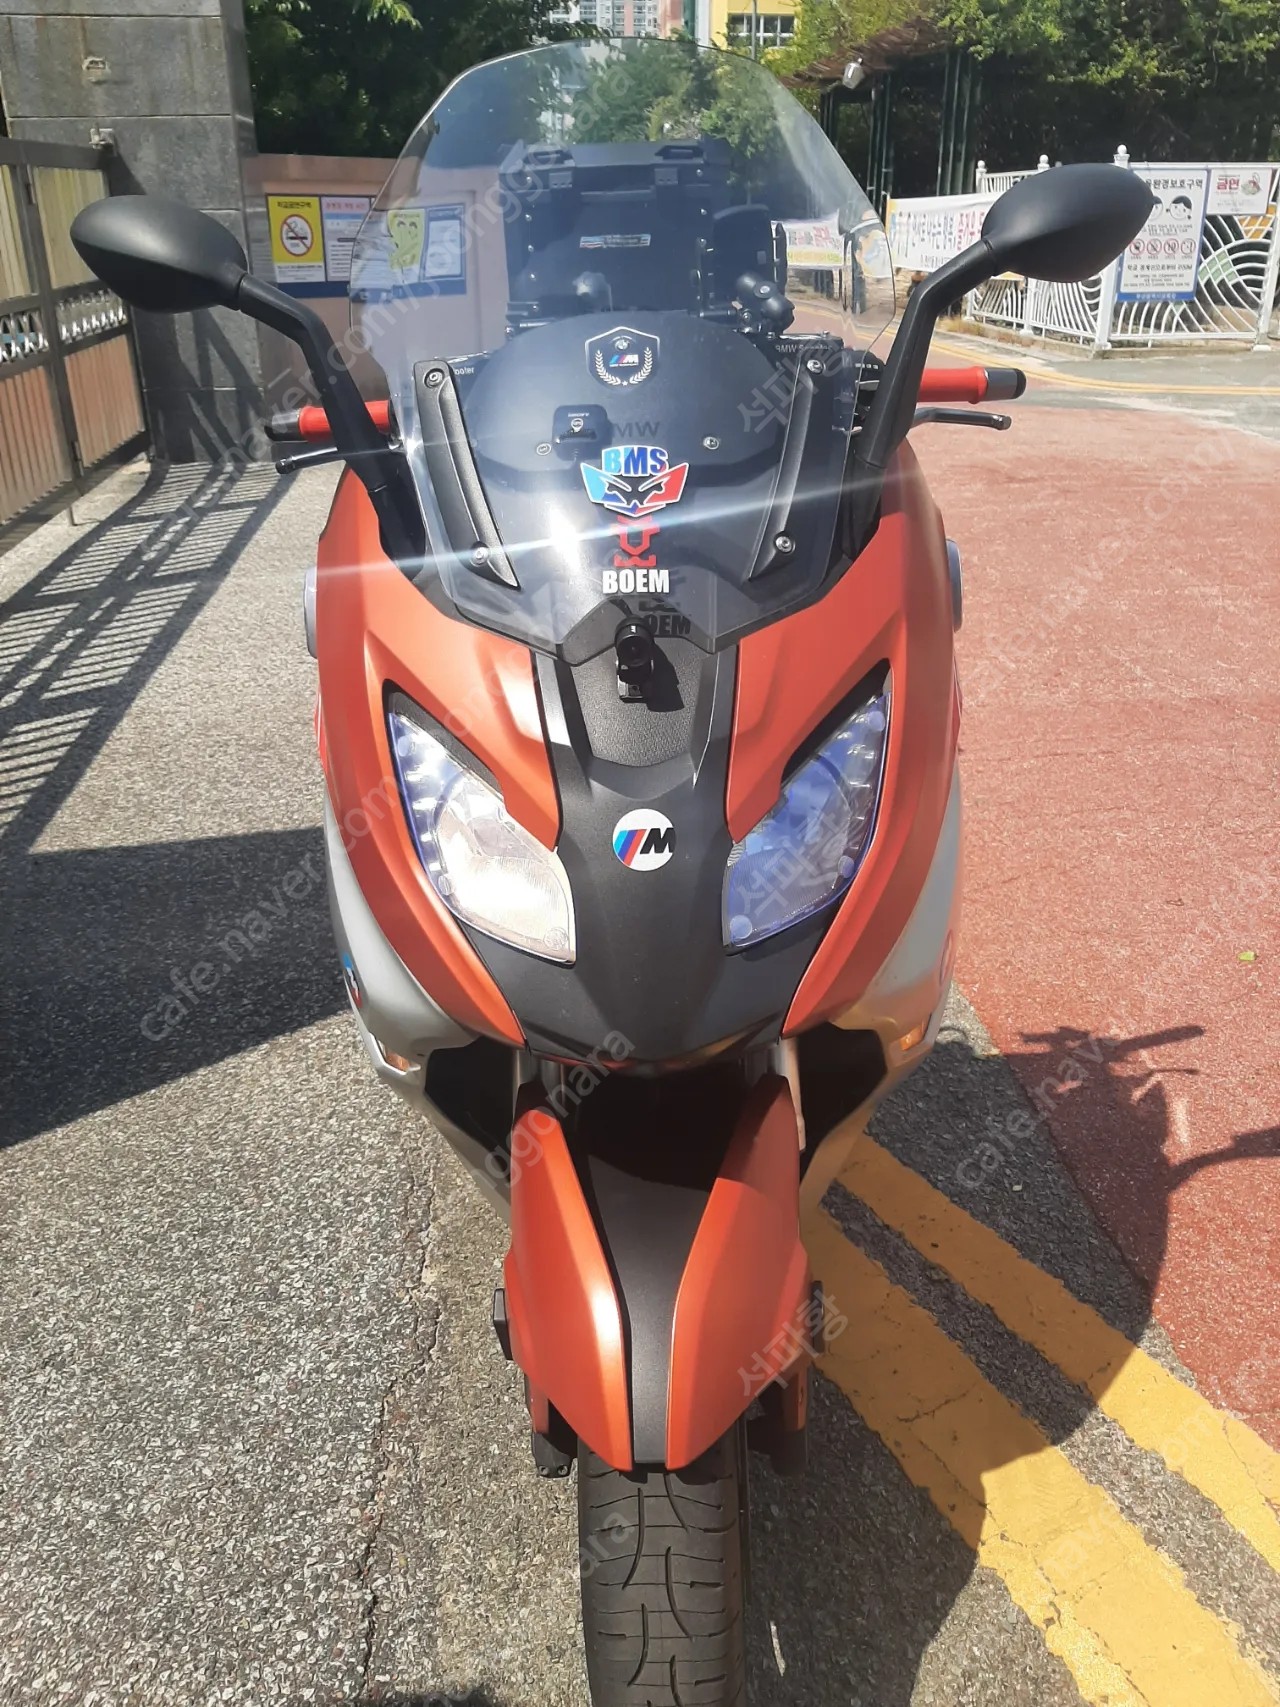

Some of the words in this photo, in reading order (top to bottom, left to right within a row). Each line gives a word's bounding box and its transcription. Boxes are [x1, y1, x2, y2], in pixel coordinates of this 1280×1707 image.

[613, 421, 660, 437] MW
[603, 446, 668, 476] BMS
[602, 568, 670, 593] BOEM
